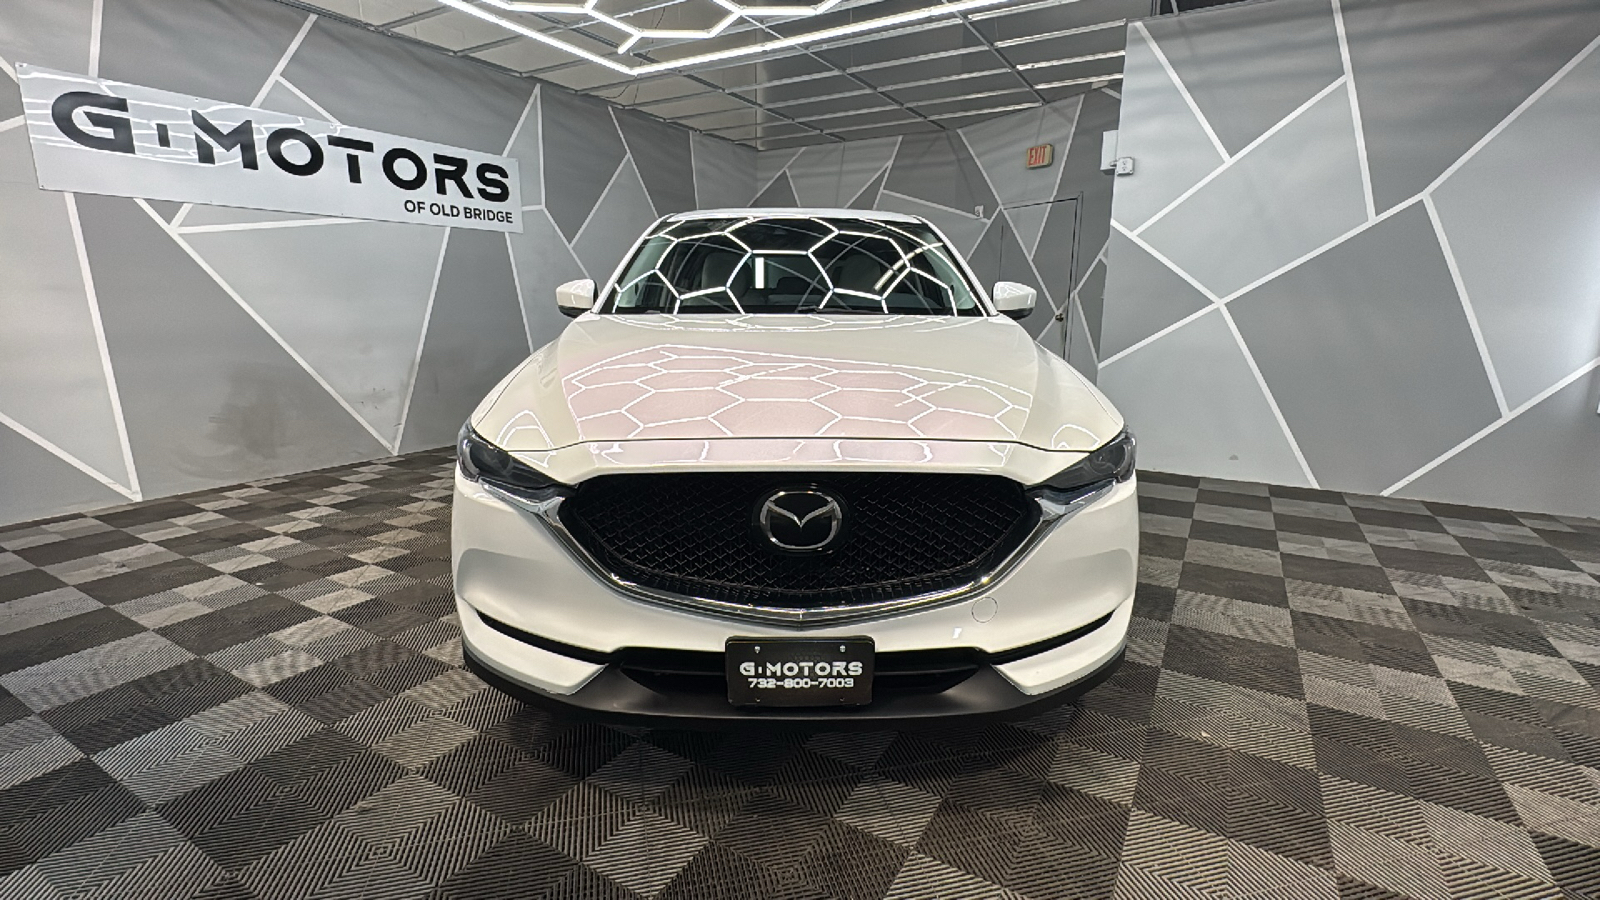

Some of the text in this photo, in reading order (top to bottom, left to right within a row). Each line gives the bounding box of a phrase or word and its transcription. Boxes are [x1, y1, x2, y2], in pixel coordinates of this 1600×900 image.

[1028, 146, 1047, 166] EXIT
[404, 200, 513, 224] OF OLD BRIDGE
[748, 678, 854, 688] 732-800-7003
